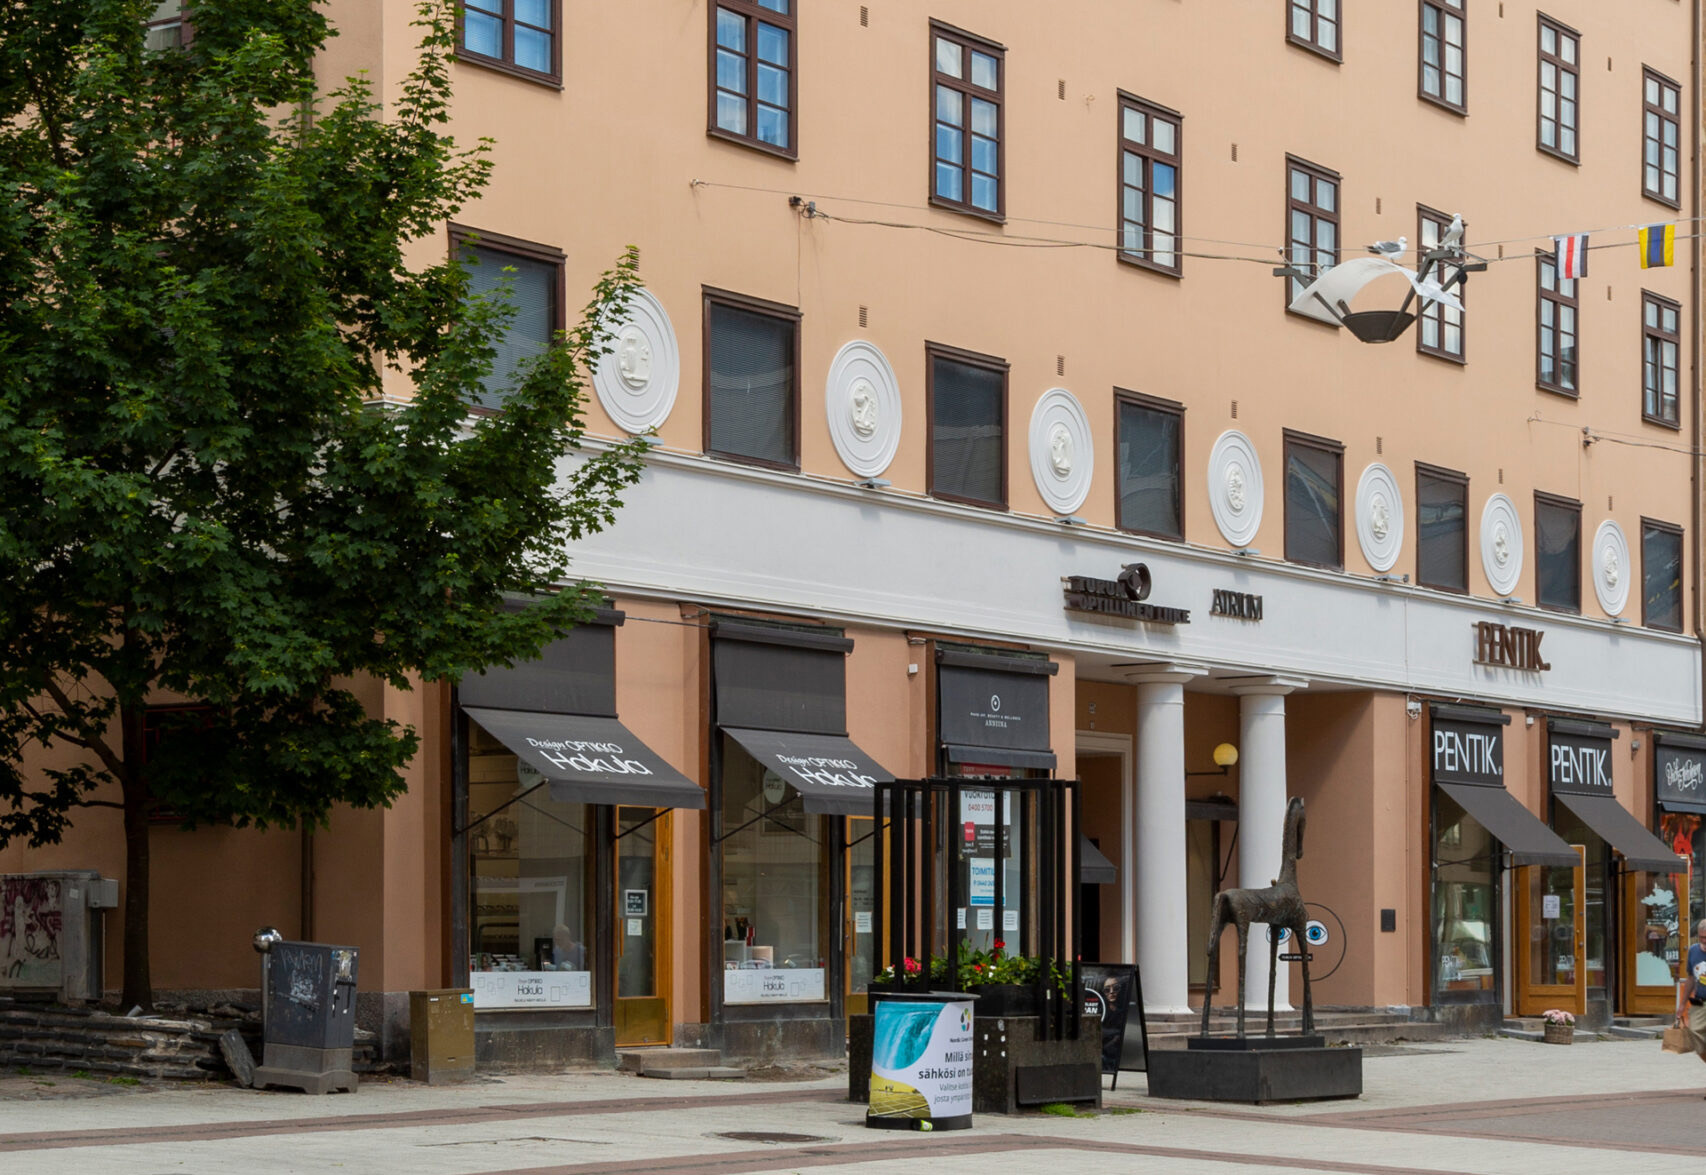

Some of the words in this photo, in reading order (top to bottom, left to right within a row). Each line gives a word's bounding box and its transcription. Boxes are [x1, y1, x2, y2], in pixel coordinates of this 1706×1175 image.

[1211, 588, 1263, 621] ATRIUM
[1155, 606, 1190, 624] LIIKE
[525, 737, 567, 752] Design
[565, 740, 624, 754] OPTIKKO
[540, 750, 653, 775] Hakula
[776, 754, 809, 767] Design
[808, 756, 858, 770] OPTIKKO
[945, 1052, 964, 1063] Millä
[918, 1068, 956, 1079] sähkösi
[957, 1070, 965, 1078] on
